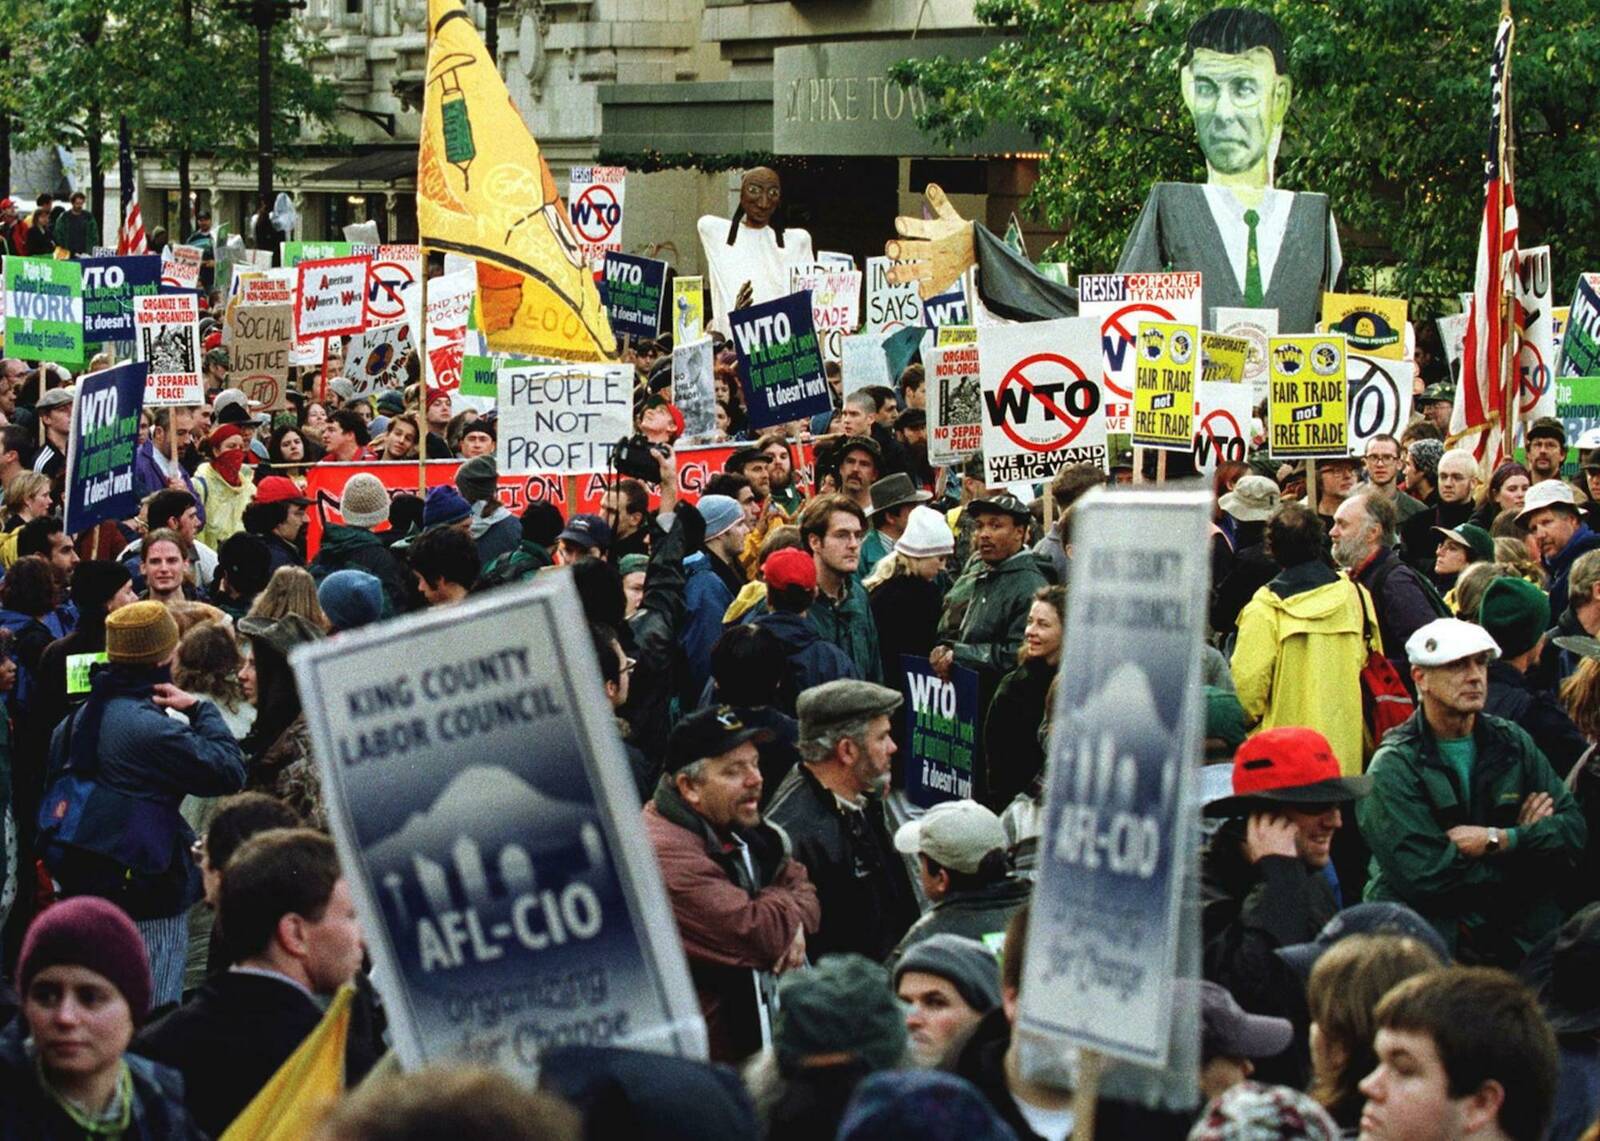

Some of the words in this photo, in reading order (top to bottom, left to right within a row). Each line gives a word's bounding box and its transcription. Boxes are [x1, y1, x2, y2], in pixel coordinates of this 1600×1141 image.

[809, 78, 859, 121] PIKE
[570, 203, 621, 225] WTO
[380, 245, 421, 254] CORPORAT
[606, 259, 643, 286] WTO
[1083, 277, 1125, 301] RESIST
[1128, 274, 1198, 288] CORPORATE
[1129, 288, 1195, 300] TYRANNY
[13, 291, 76, 322] WORK
[143, 298, 176, 310] ORGANIZE
[178, 297, 191, 309] THE
[425, 304, 470, 323] LOCKA
[871, 293, 919, 324] SAYS
[926, 300, 967, 327] WT
[85, 315, 92, 331] it
[95, 313, 131, 329] doesn't
[236, 311, 291, 342] SOCIAL
[813, 306, 849, 327] RADE
[735, 312, 792, 355] WTO
[1207, 336, 1247, 355] CORPORATE
[230, 346, 286, 373] JUSTICE
[157, 374, 198, 387] SEPARATE
[511, 369, 627, 406] PEOPLE
[765, 386, 776, 408] it
[776, 378, 807, 406] doesn't
[805, 372, 827, 397] work
[1138, 367, 1158, 391] FAIR
[1162, 368, 1192, 393] TRADE
[156, 387, 185, 399] PEACE!
[984, 379, 1101, 428] WTO
[1153, 394, 1172, 409] not
[1273, 381, 1298, 404] FAIR
[1303, 381, 1342, 402] TRADE
[81, 385, 119, 436] WTO
[535, 410, 602, 433] NOT
[1295, 405, 1318, 421] not
[1556, 403, 1600, 422] conomy
[934, 428, 949, 440] NO
[1136, 411, 1156, 434] FREE
[1160, 413, 1190, 437] TRADE
[1274, 423, 1300, 445] FREE
[1306, 422, 1343, 445] TRADE
[507, 437, 618, 469] PROFIT
[950, 438, 981, 450] PEACE!
[990, 456, 1018, 469] WE
[1023, 446, 1105, 466] DEMAND
[990, 465, 1046, 482] PUBLIC
[346, 678, 418, 722] KING
[420, 646, 531, 702] COUNTY
[907, 671, 957, 720] WTO
[338, 717, 429, 767] LABOR
[435, 684, 565, 744] COUNCIL
[416, 882, 603, 975] AFL-CIO
